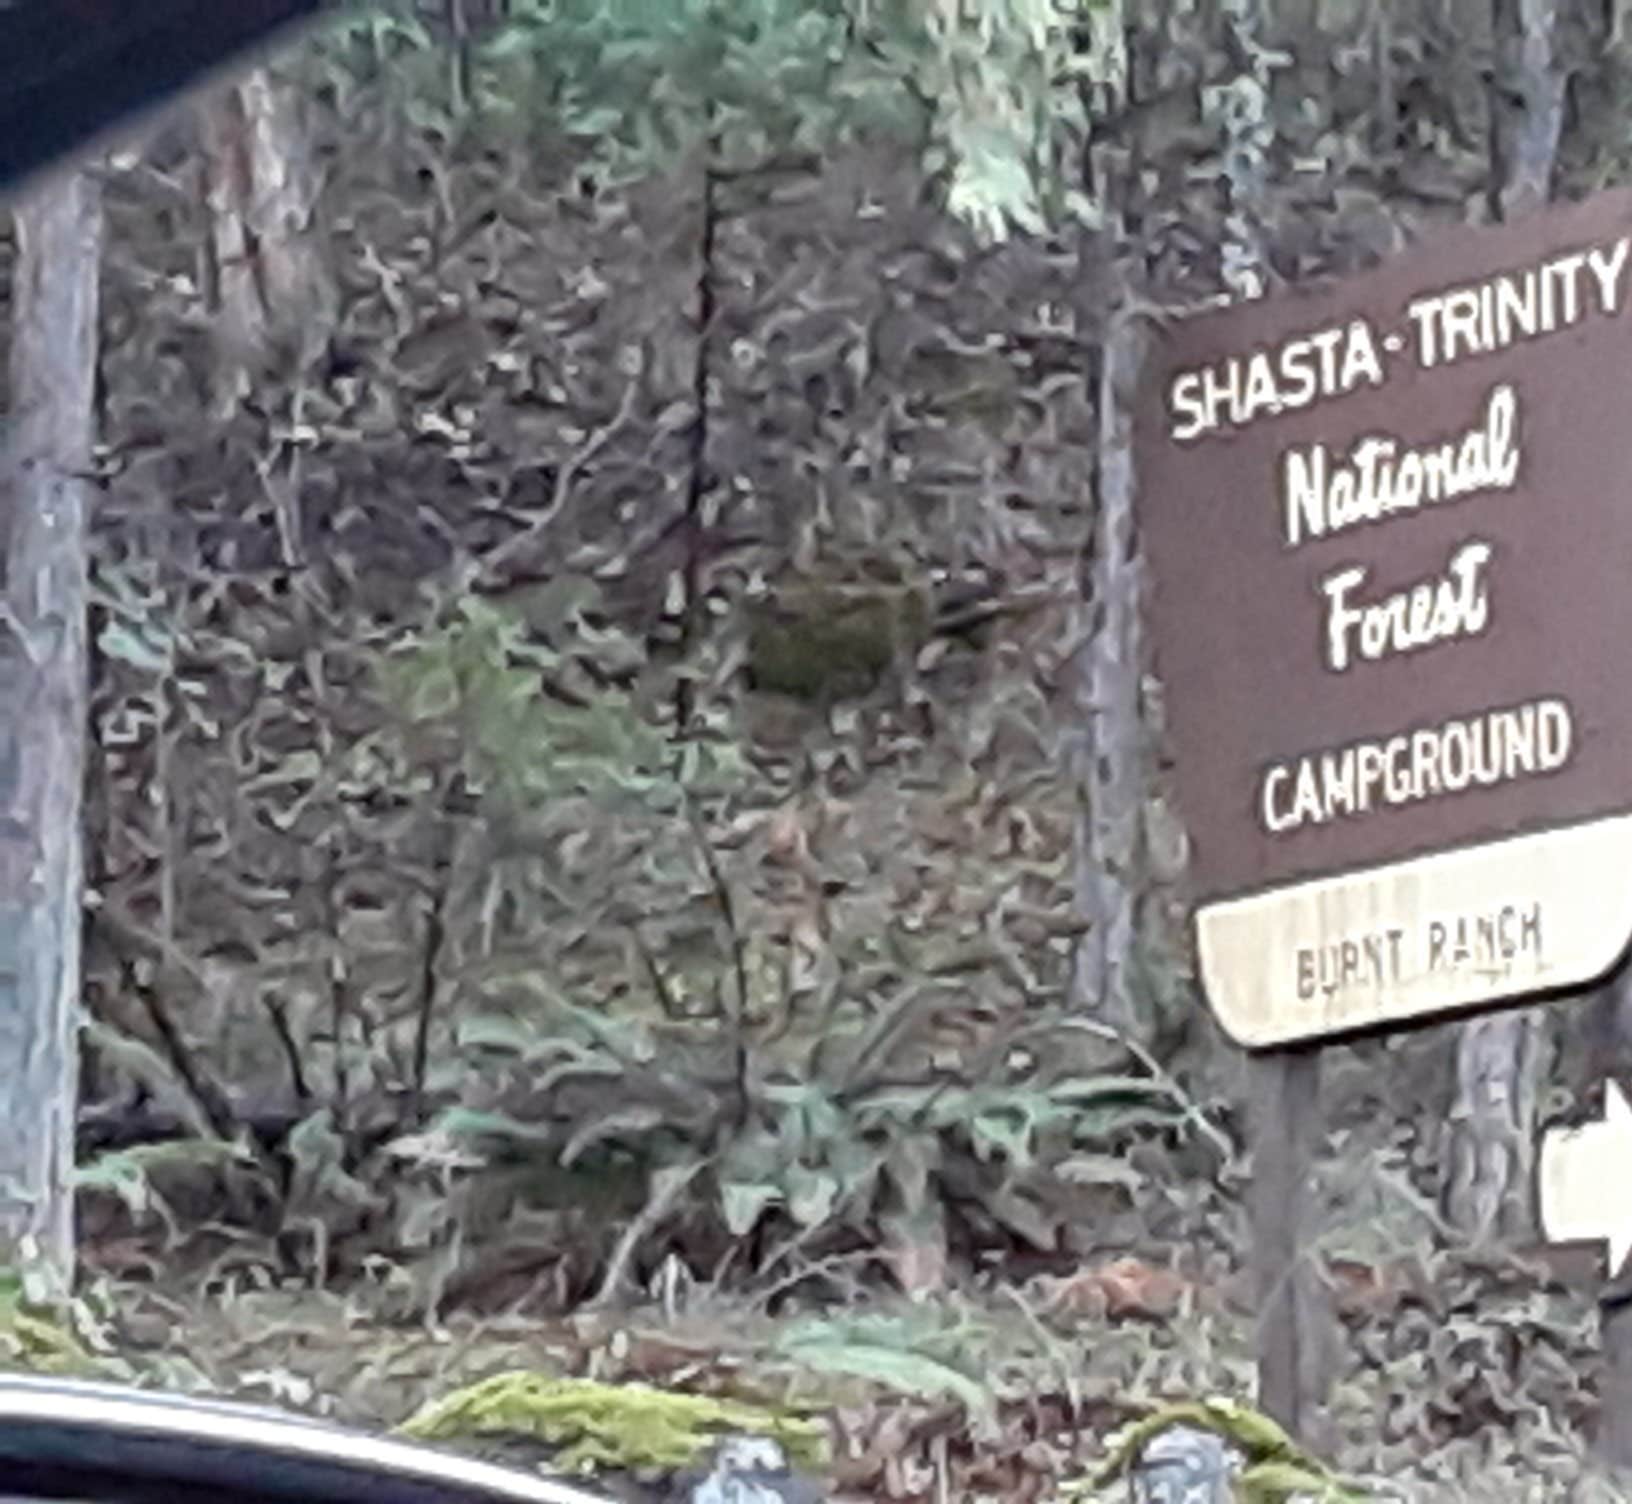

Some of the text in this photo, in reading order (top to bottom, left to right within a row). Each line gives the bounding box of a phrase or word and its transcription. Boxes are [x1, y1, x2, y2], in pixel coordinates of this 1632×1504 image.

[1285, 385, 1520, 546] National
[1322, 542, 1491, 671] Forest
[1262, 700, 1572, 832] CAMPGROUND
[1296, 901, 1542, 1000] BURNT RANCH
